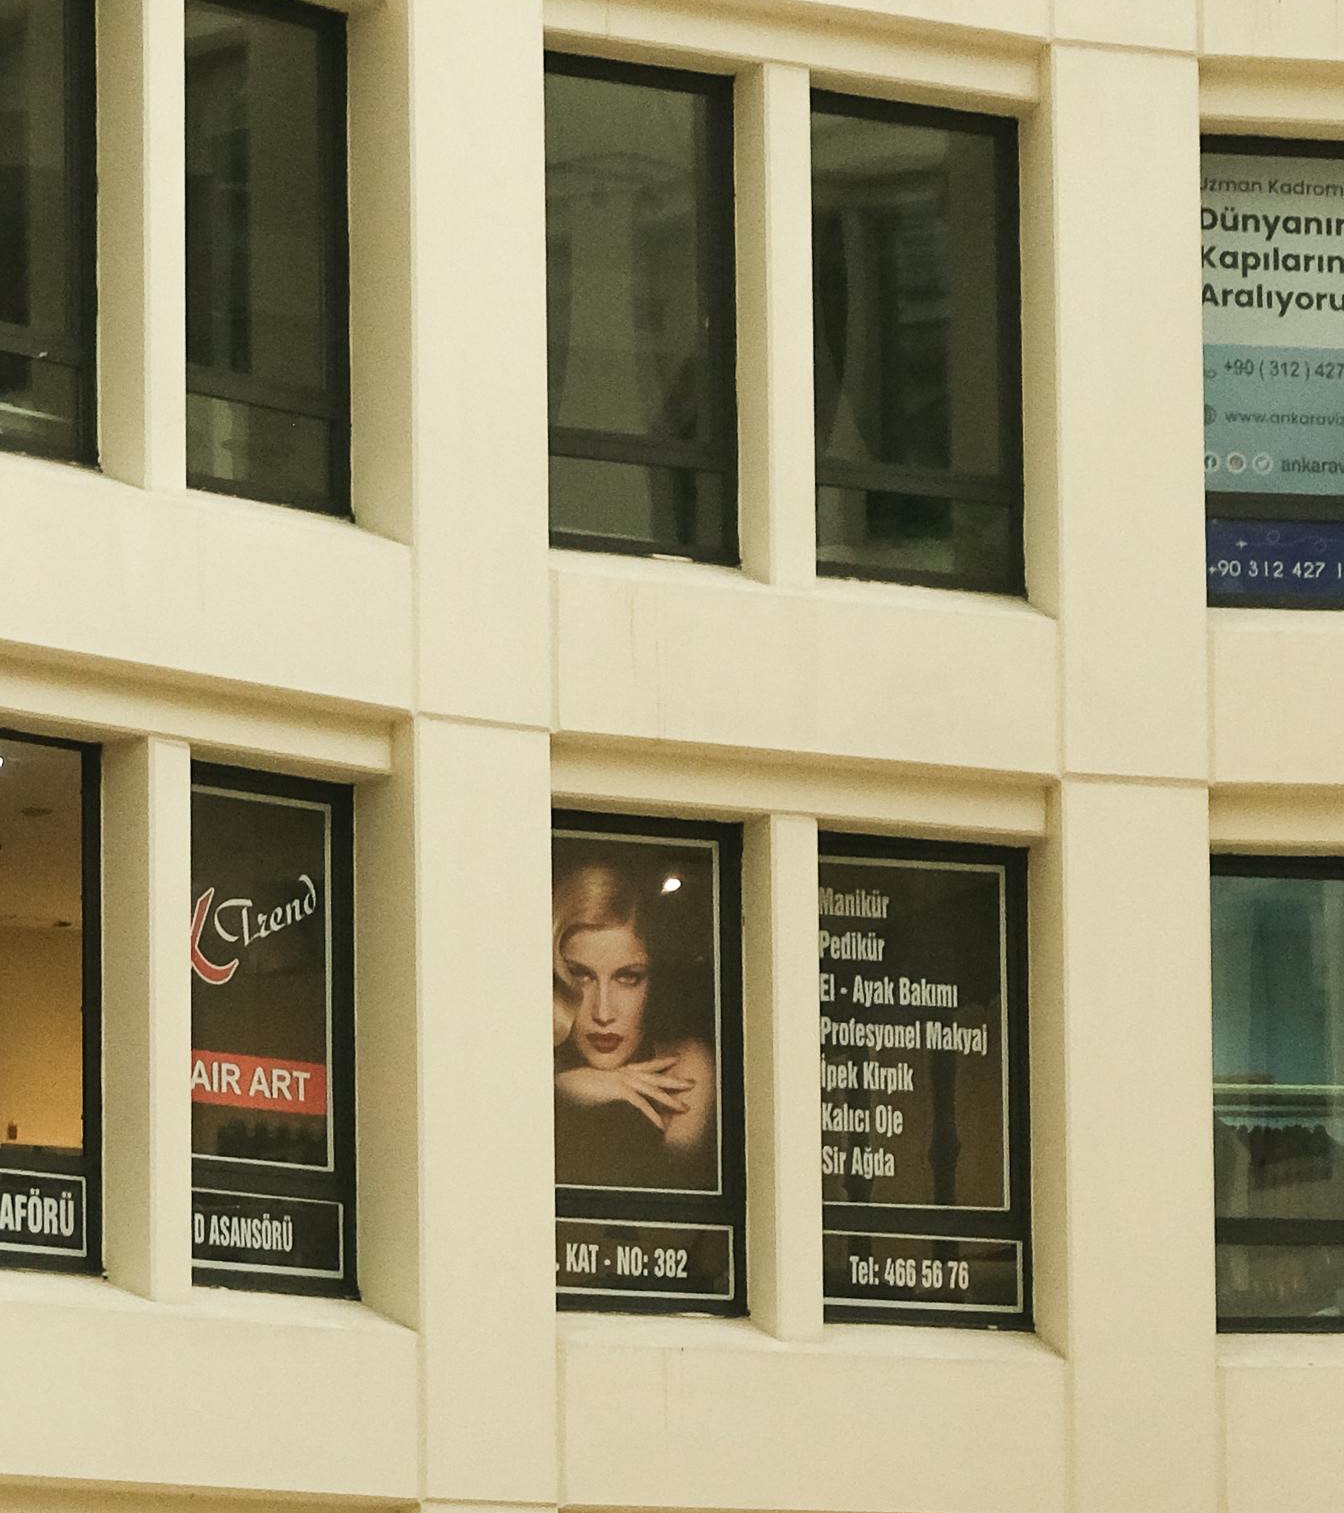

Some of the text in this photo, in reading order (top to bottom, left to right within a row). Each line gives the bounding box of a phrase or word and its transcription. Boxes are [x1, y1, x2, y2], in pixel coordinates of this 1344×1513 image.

[1315, 362, 1344, 379] 427
[1208, 560, 1242, 576] +90
[1248, 560, 1284, 578] 312
[1292, 561, 1326, 579] 427
[214, 874, 317, 947] Trend
[819, 887, 889, 919] Manikür
[819, 930, 885, 962] Pedikür
[820, 973, 835, 1002] El
[852, 975, 894, 1007] Ayak
[898, 976, 958, 1008] Bakımı
[820, 1016, 988, 1056] Profesyonel Makyaj
[249, 1066, 311, 1102] ART
[863, 1061, 914, 1094] Kirpik
[822, 1102, 904, 1137] Kalıcı Oje
[822, 1145, 895, 1179] Sir Ağda
[209, 1213, 293, 1253] ASANSÖRÜ
[566, 1243, 600, 1274] KAT
[617, 1246, 649, 1276] NO:
[654, 1248, 688, 1279] 382
[849, 1255, 970, 1290] Tel: 466 56 76
